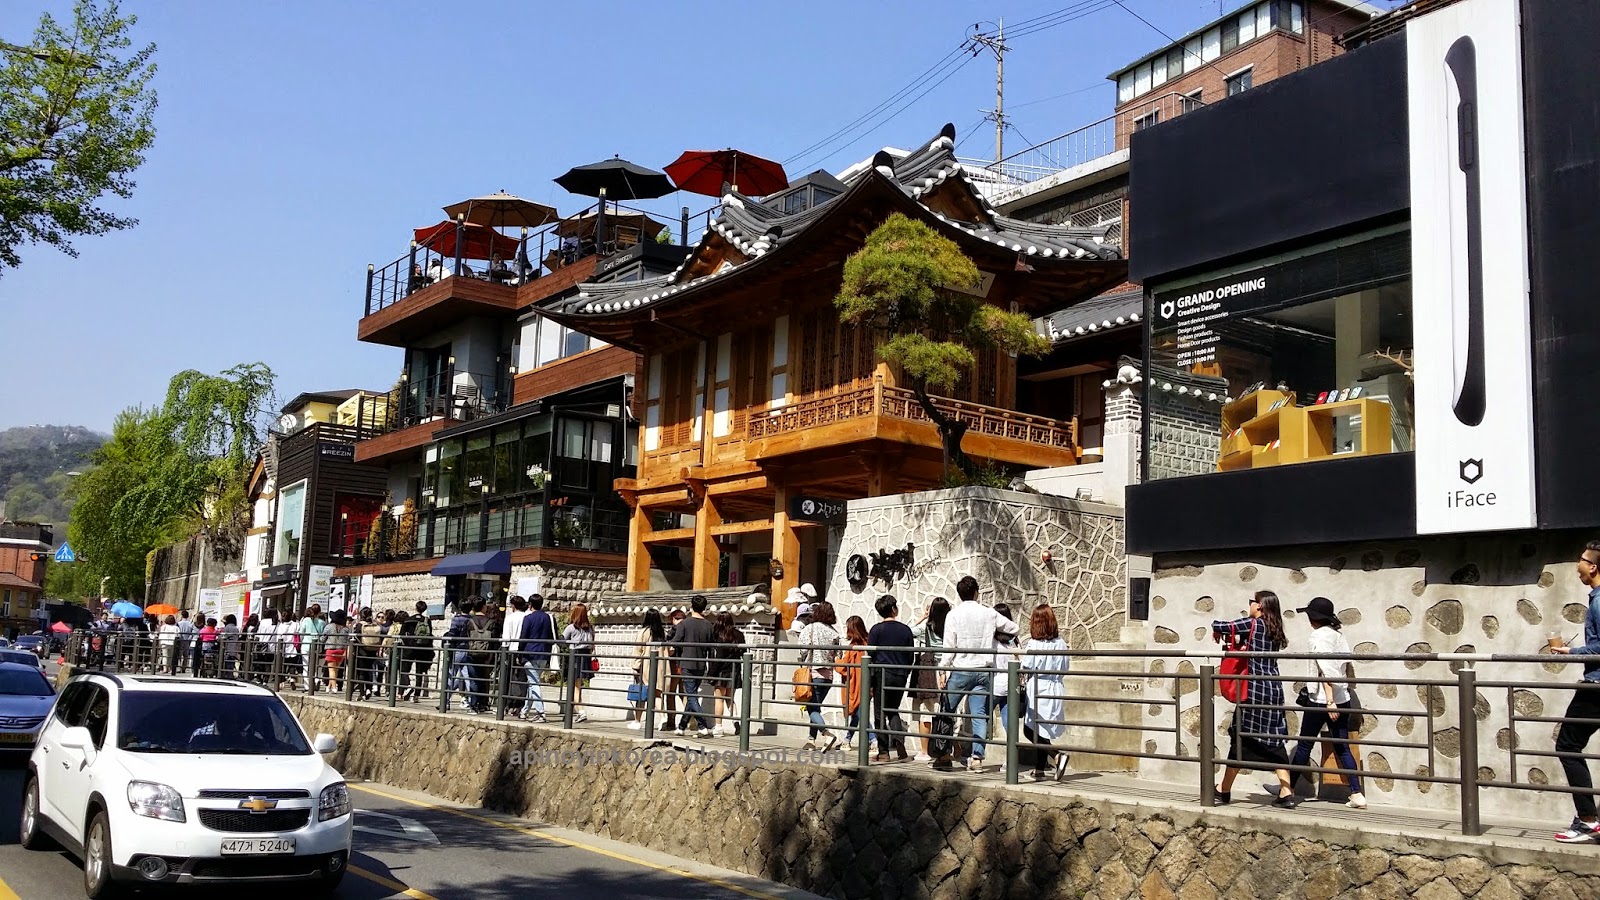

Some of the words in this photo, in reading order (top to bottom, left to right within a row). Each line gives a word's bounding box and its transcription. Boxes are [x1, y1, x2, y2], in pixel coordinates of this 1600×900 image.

[1177, 290, 1214, 308] GRAND
[1215, 277, 1266, 299] OPENING
[1177, 307, 1201, 317] Creative
[1200, 302, 1221, 312] Design
[1177, 319, 1191, 328] Smart
[1190, 316, 1205, 325] device
[1204, 311, 1230, 321] accessories
[1177, 326, 1192, 335] Design
[1192, 323, 1207, 332] goods
[1193, 330, 1214, 340] products
[1200, 335, 1221, 345] products
[1177, 351, 1192, 360] OPEN
[1177, 359, 1192, 367] CLOSE
[1447, 490, 1497, 508] iFace
[259, 840, 290, 852] 5240
